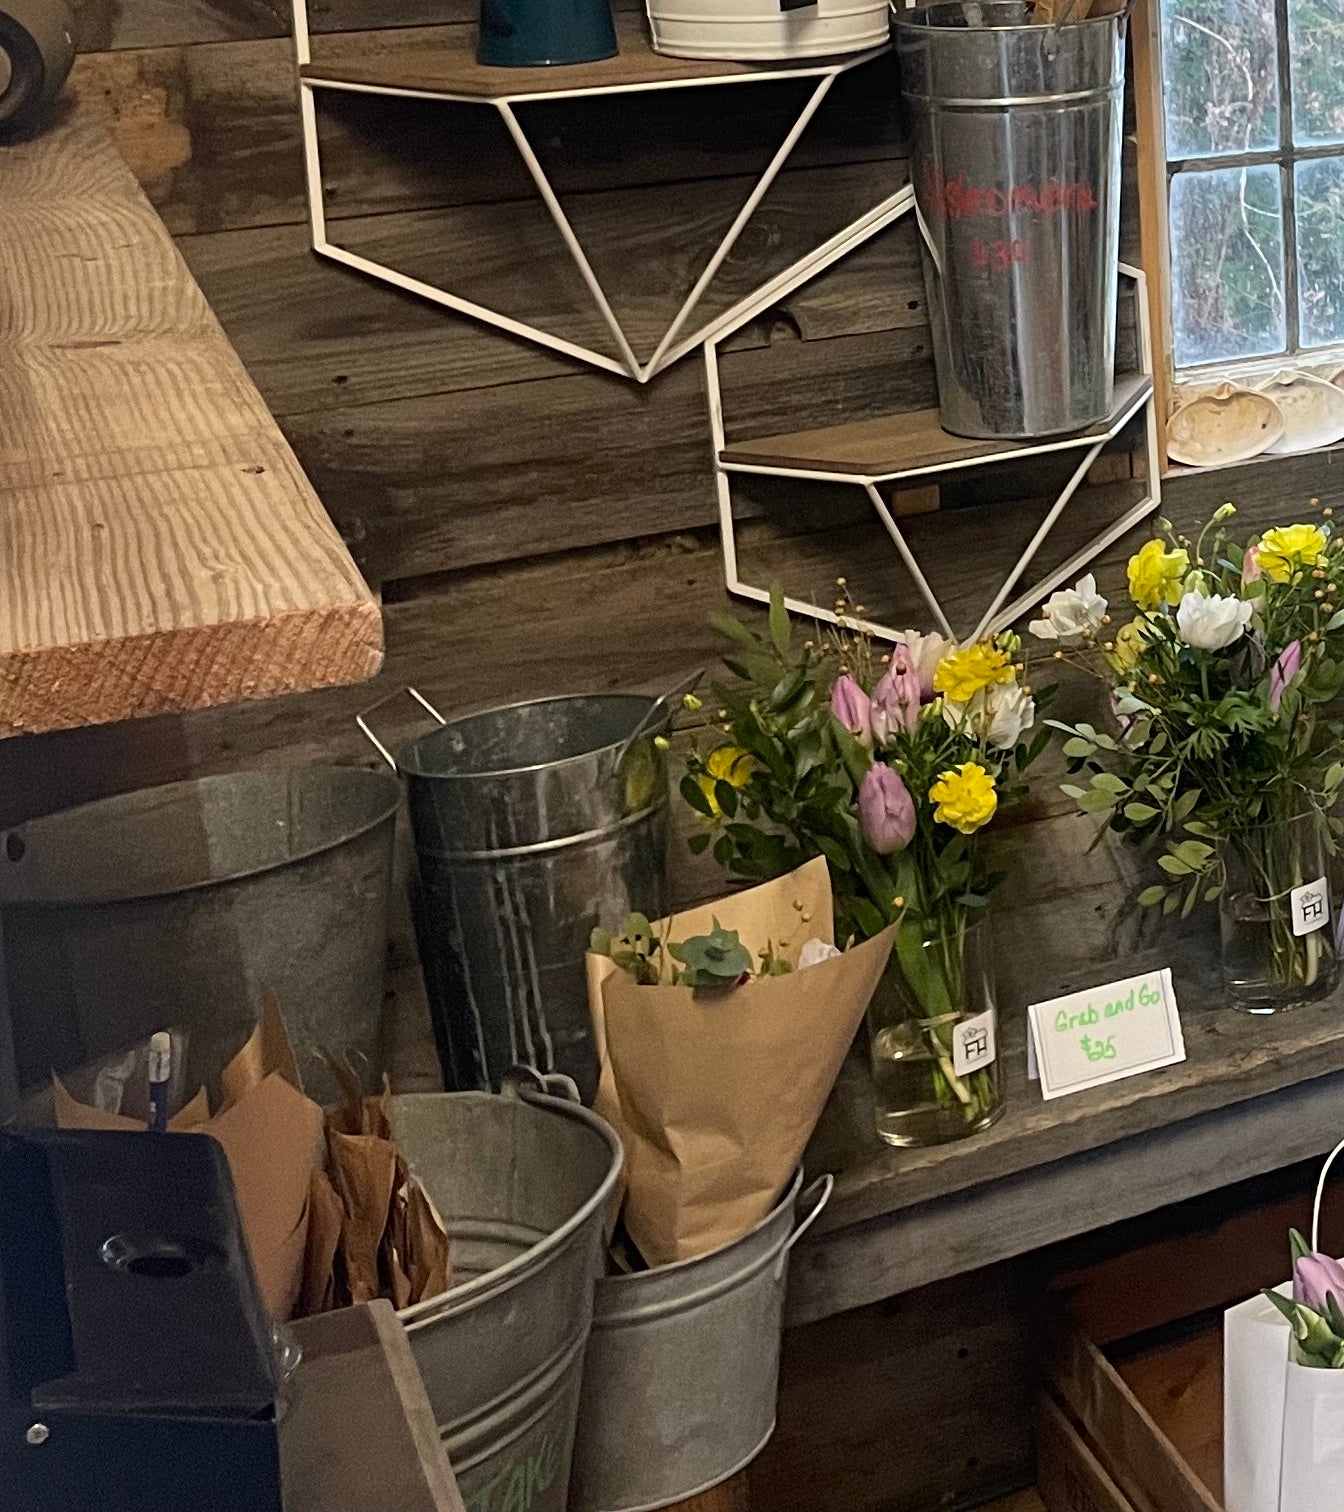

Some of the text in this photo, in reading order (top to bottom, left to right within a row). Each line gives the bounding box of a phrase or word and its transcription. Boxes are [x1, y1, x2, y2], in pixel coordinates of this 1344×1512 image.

[1054, 983, 1161, 1032] Grab and Go
